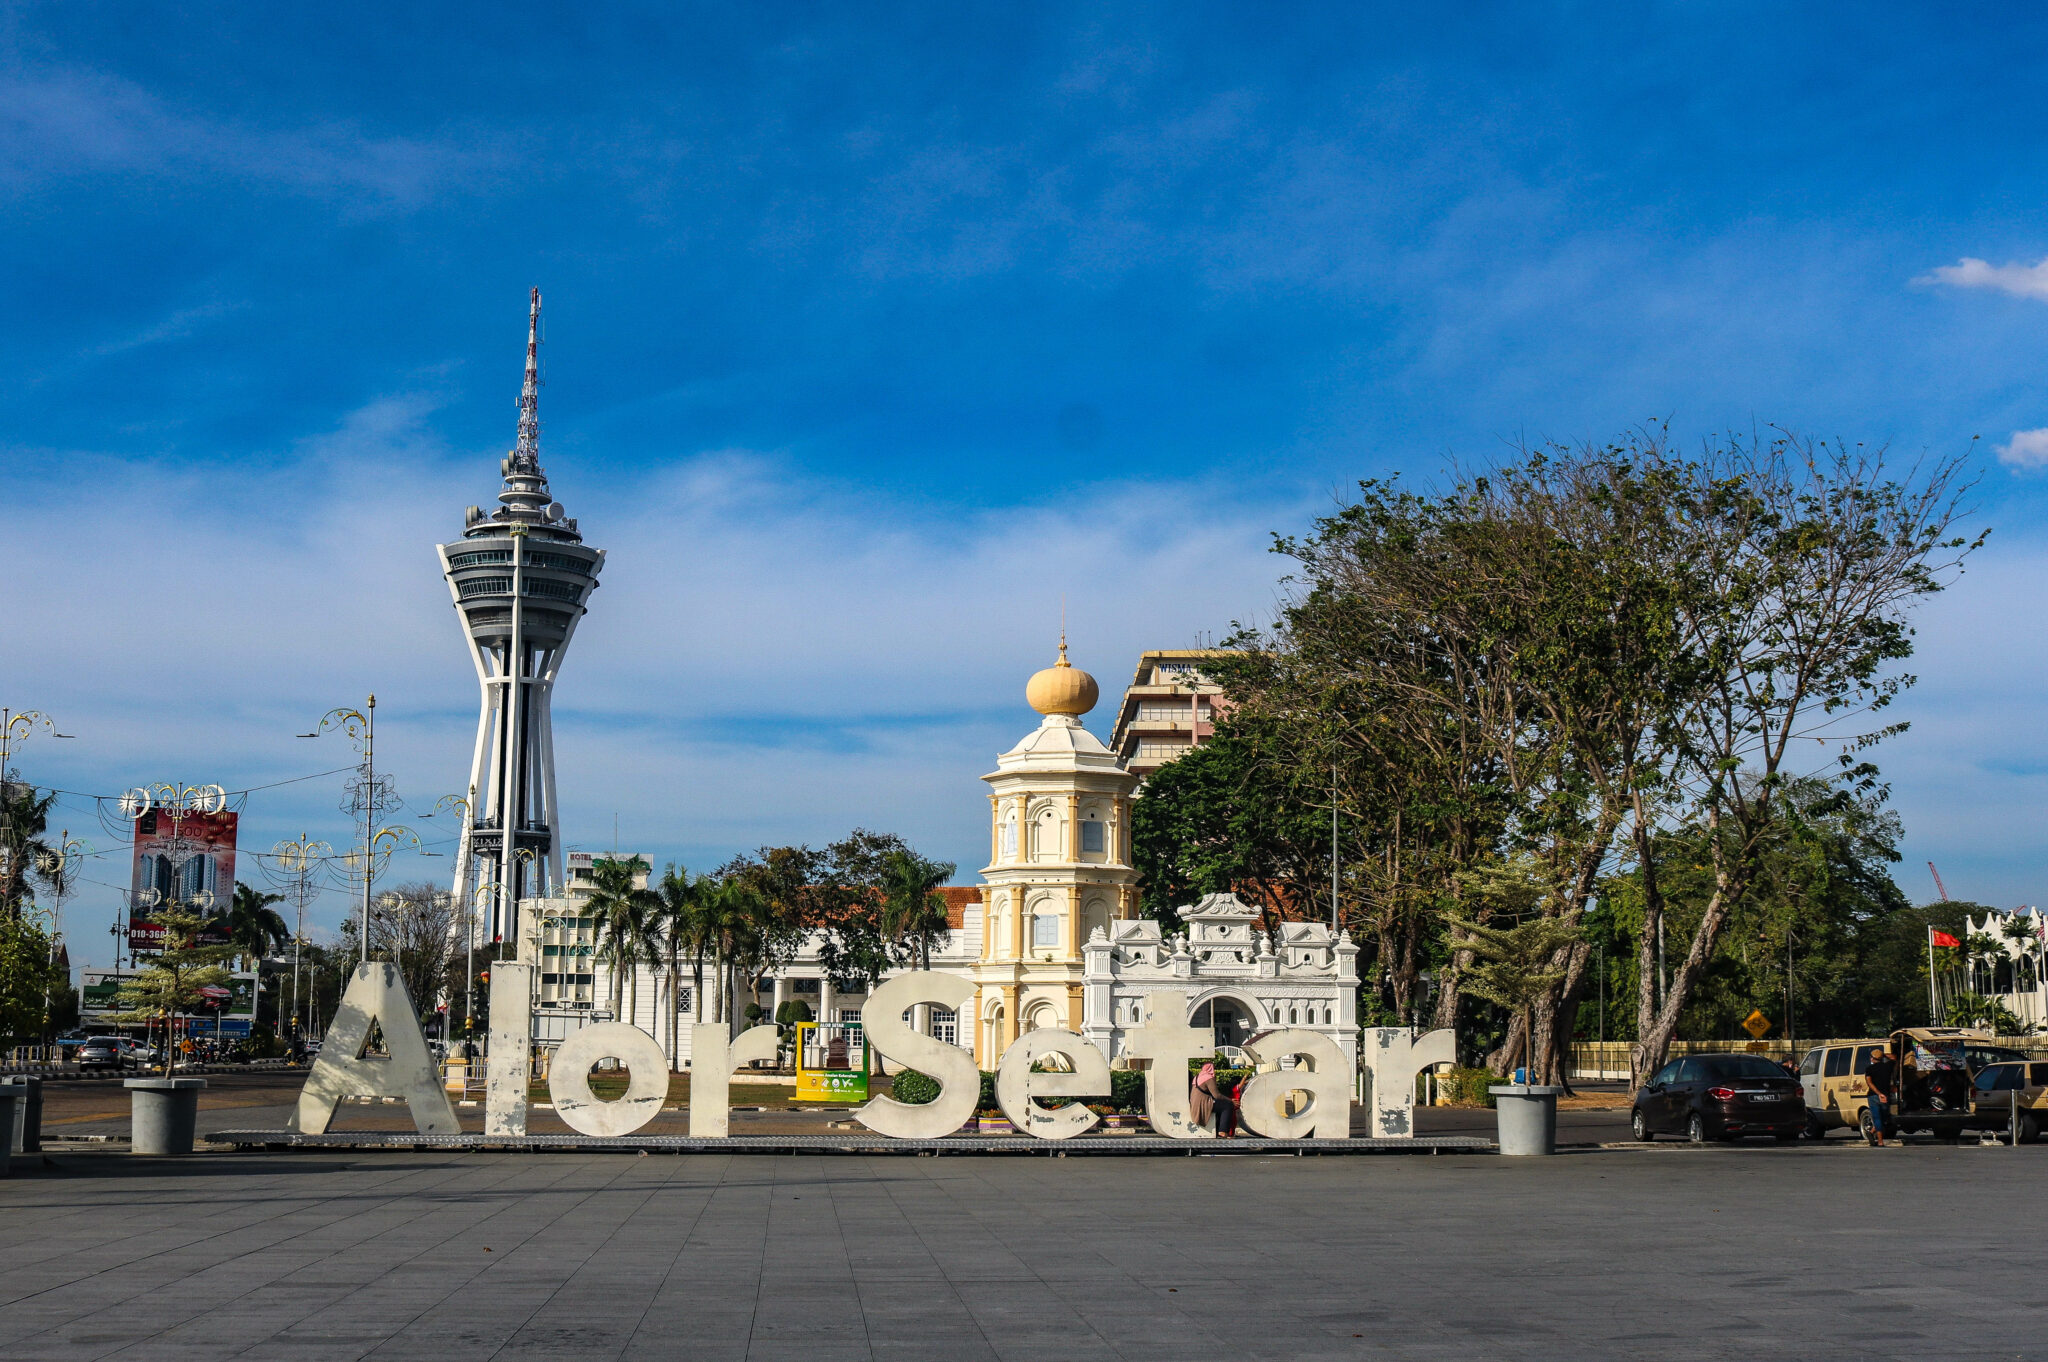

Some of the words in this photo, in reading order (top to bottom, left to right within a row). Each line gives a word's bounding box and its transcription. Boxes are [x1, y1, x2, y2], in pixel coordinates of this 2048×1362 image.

[1159, 663, 1192, 673] WISMA
[287, 960, 777, 1138] Alor
[853, 970, 1456, 1139] Setar
